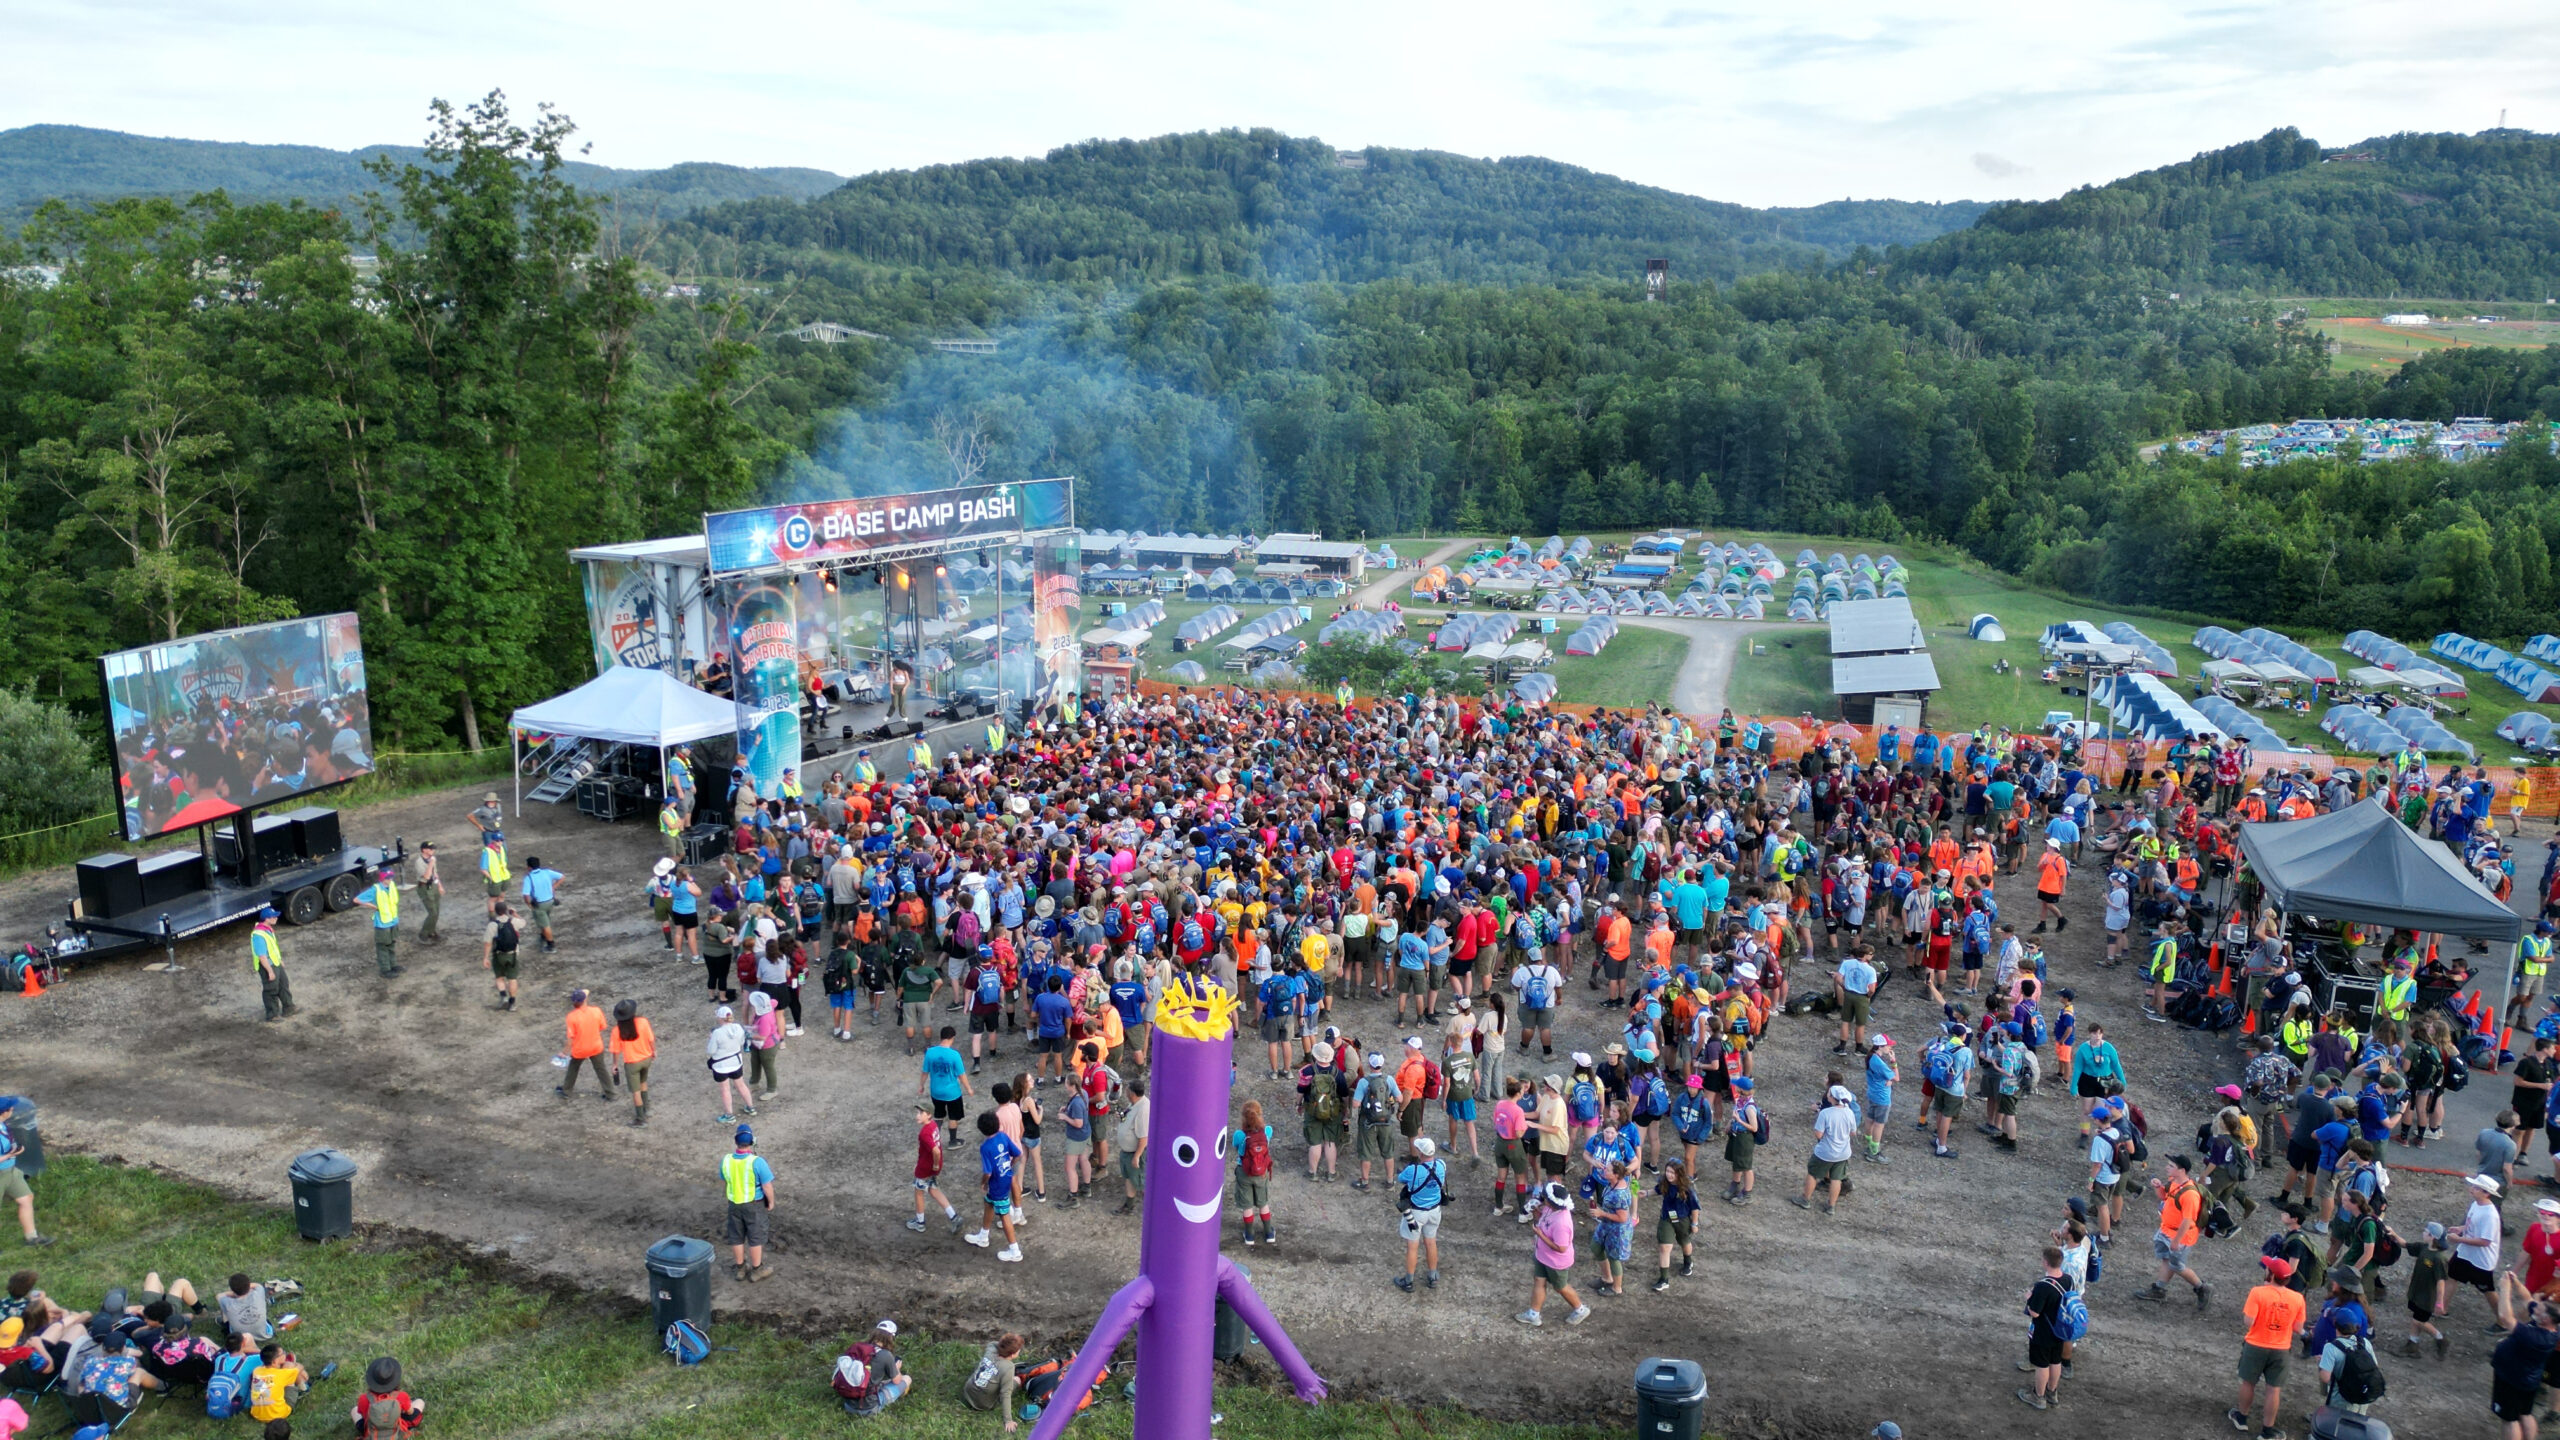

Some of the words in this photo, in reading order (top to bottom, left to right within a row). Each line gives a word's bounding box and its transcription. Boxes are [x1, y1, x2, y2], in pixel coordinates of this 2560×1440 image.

[823, 511, 885, 540] BASE
[890, 503, 954, 531] CAMP
[959, 496, 1016, 523] BASH
[1042, 574, 1080, 596] NAONAL
[741, 621, 793, 652] NATIONAL
[1053, 635, 1072, 650] 223
[742, 641, 797, 675] JAMBOREE
[761, 692, 791, 713] 2023
